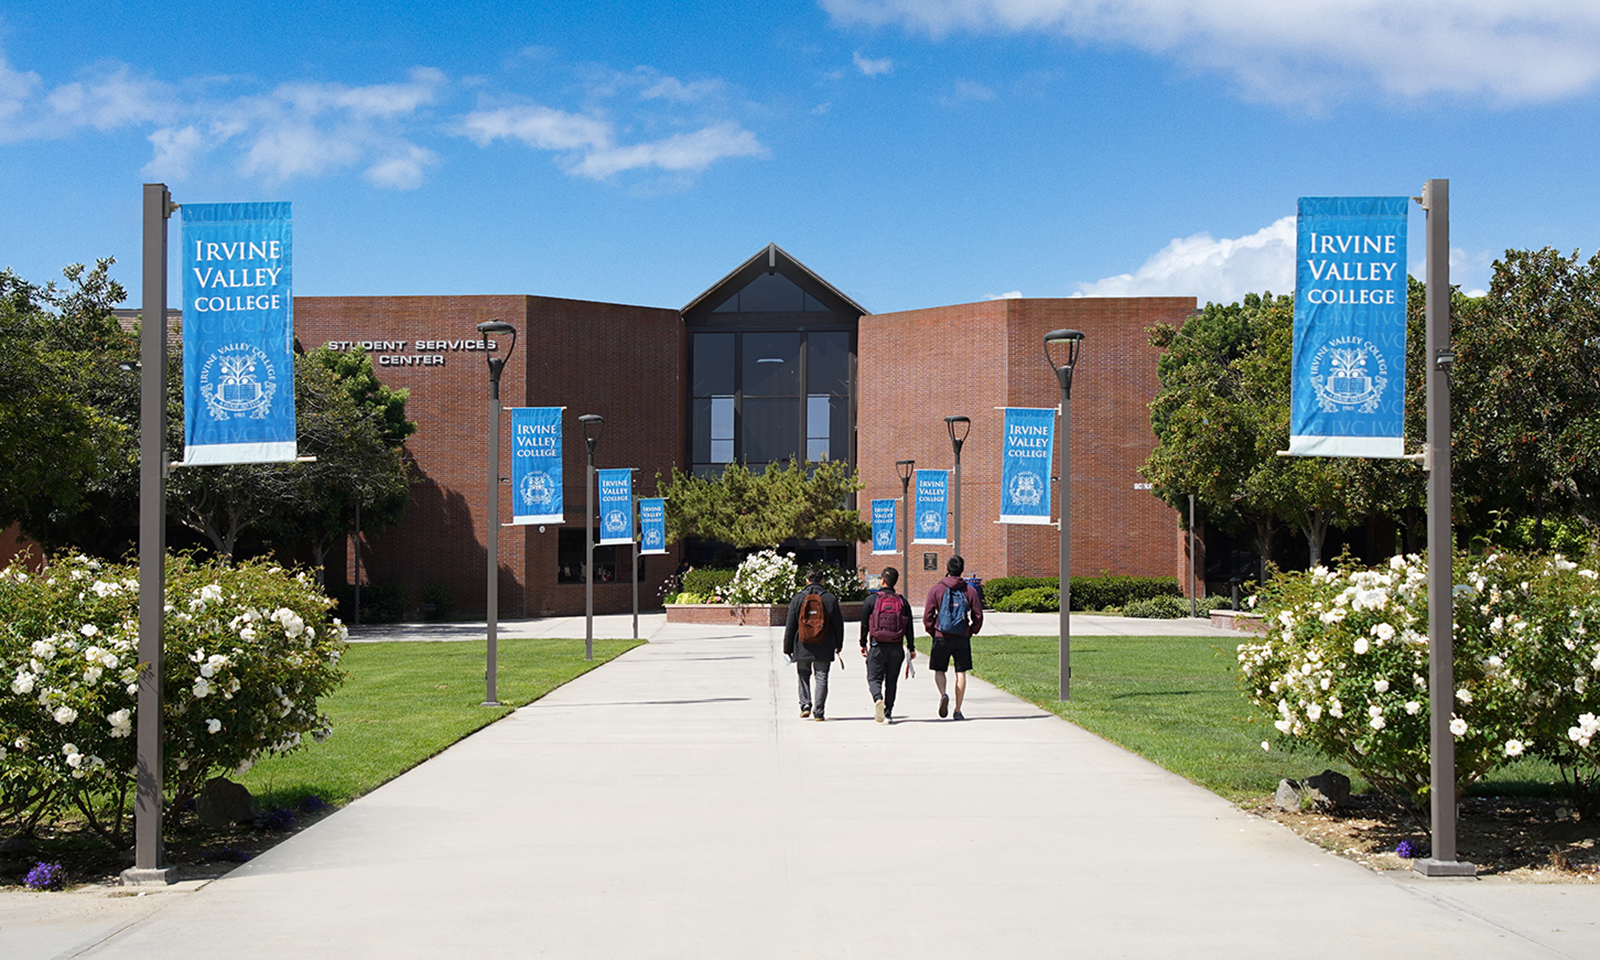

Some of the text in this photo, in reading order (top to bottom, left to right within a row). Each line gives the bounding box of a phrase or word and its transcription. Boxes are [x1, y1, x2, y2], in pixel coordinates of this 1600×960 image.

[1310, 232, 1396, 254] IRVINE
[195, 240, 281, 261] IRVINE
[1307, 259, 1397, 281] VALLEY
[193, 267, 282, 288] VALLEY
[194, 294, 280, 312] COLLEGE
[1307, 289, 1395, 304] COLLEGE
[415, 340, 497, 350] SERVICES
[379, 355, 444, 365] CENTER
[1310, 336, 1387, 375] IRVINE VALLEY COLLEGE
[200, 343, 276, 383] IRVINE VALLEY COLLEGE
[518, 424, 556, 434] IRVINE
[1010, 424, 1048, 435] IRVINE
[517, 436, 556, 446] VALLEY
[1009, 436, 1048, 447] VALLEY
[517, 449, 556, 457] COLLEGE
[1008, 449, 1047, 458] COLLEGE
